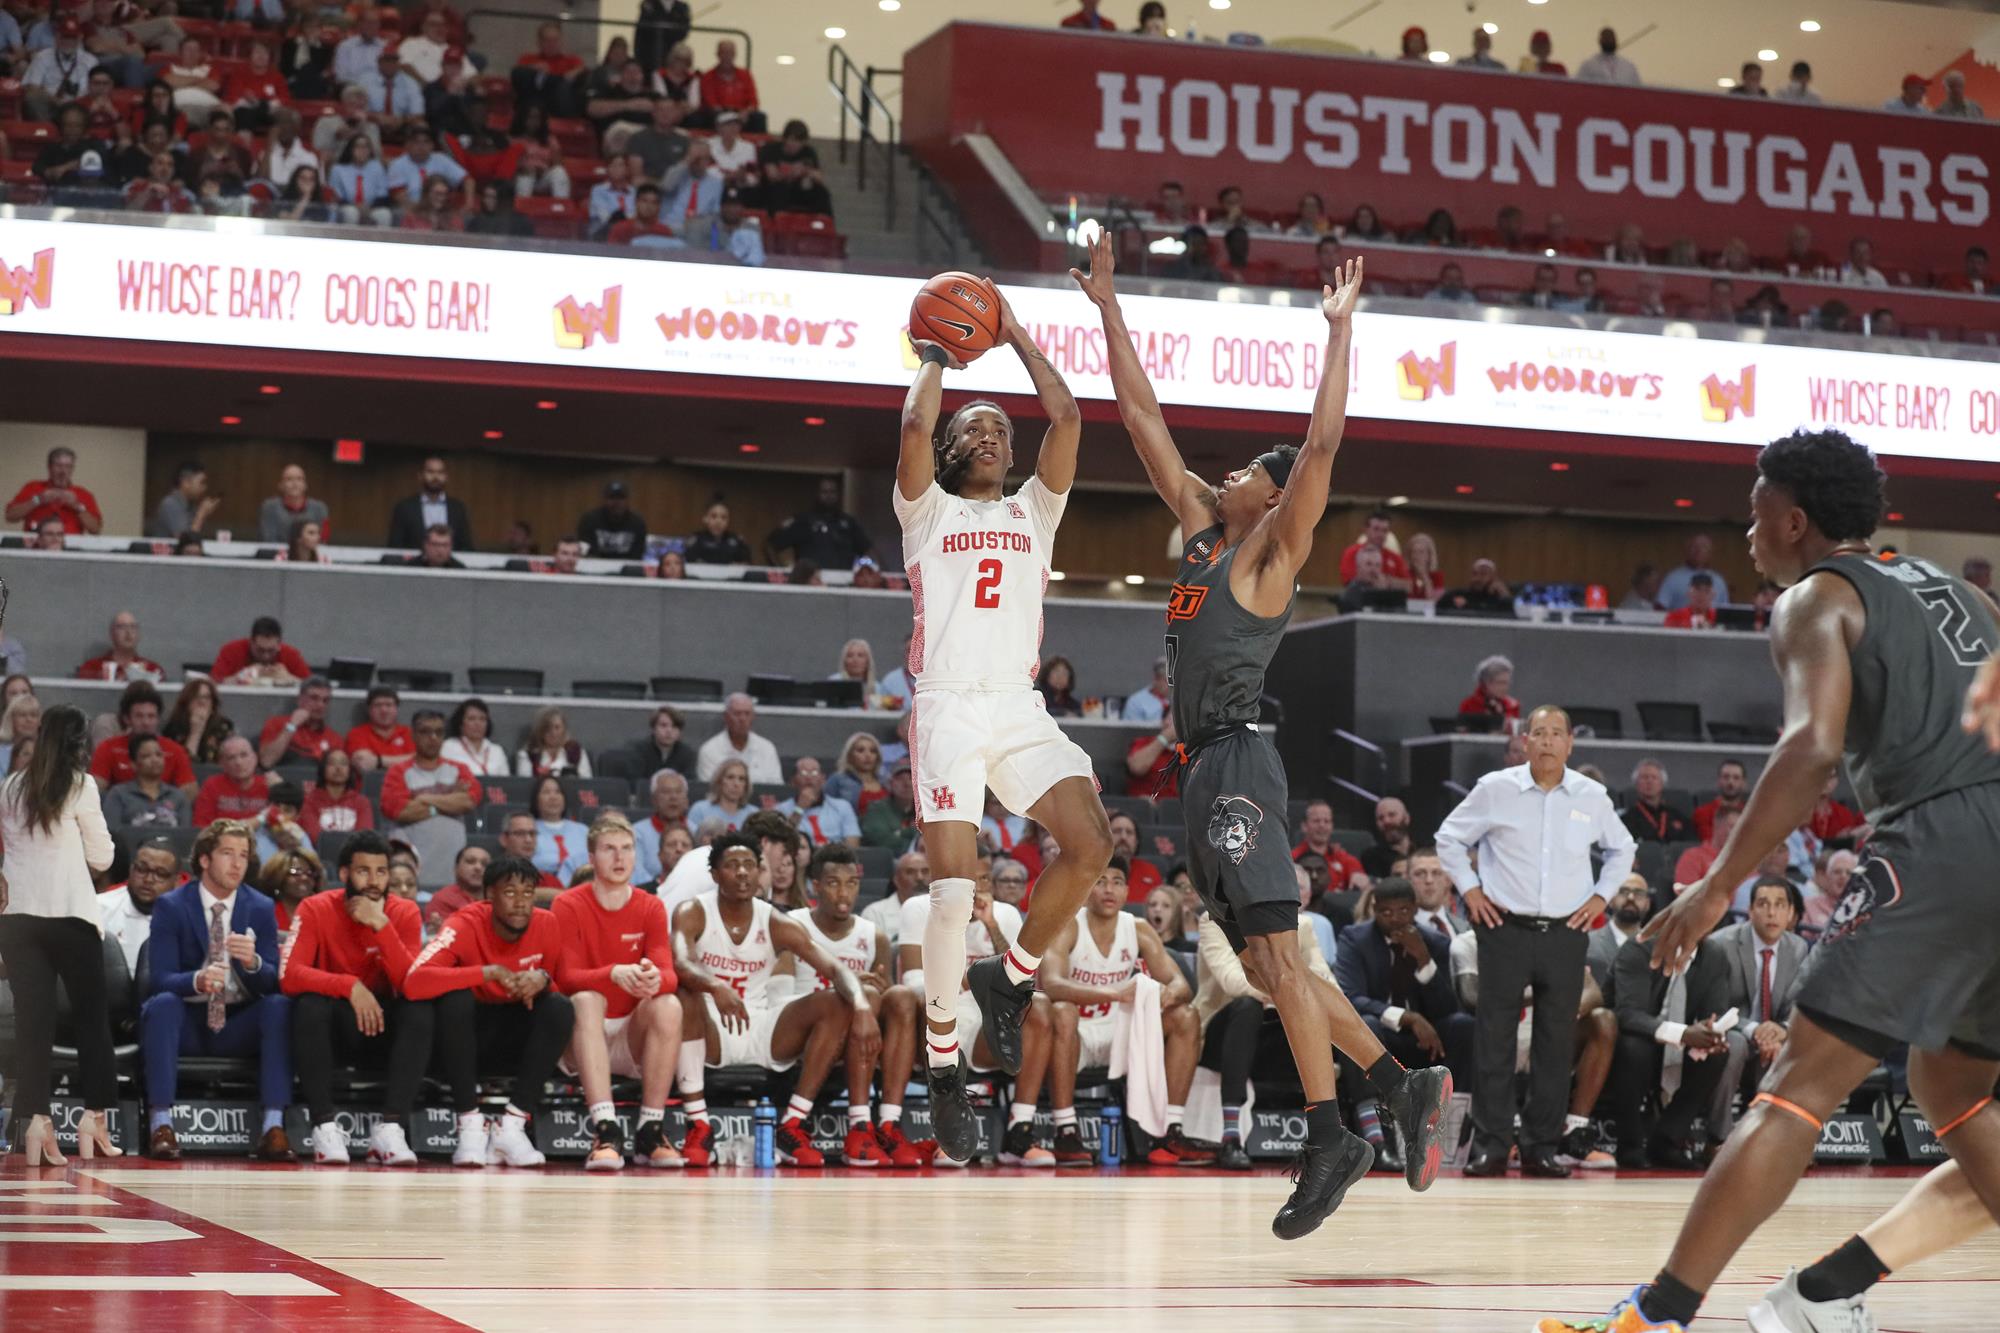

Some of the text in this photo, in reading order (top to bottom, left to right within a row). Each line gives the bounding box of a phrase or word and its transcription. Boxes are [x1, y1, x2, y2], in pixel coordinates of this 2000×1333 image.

[1095, 70, 1992, 227] HOUSTON COUGARS
[117, 258, 490, 333] WHOSE BAR? COOGS BAR!
[655, 307, 859, 349] WOODROW'S
[1025, 322, 1110, 376] WHOS
[1130, 330, 1190, 381] AR?
[1212, 336, 1294, 389] COOGS
[1486, 361, 1664, 401] WOODROW'S
[1808, 376, 1888, 427] WHOSE
[1895, 384, 1950, 431] BAR?
[942, 530, 1032, 554] HOUSTON
[974, 558, 1003, 609] 2
[1911, 584, 1994, 667] 2
[700, 952, 768, 973] HOUSTON
[175, 1132, 250, 1145] hiropractic
[708, 1115, 752, 1139] OINT
[1814, 1143, 1871, 1154] hiropractic
